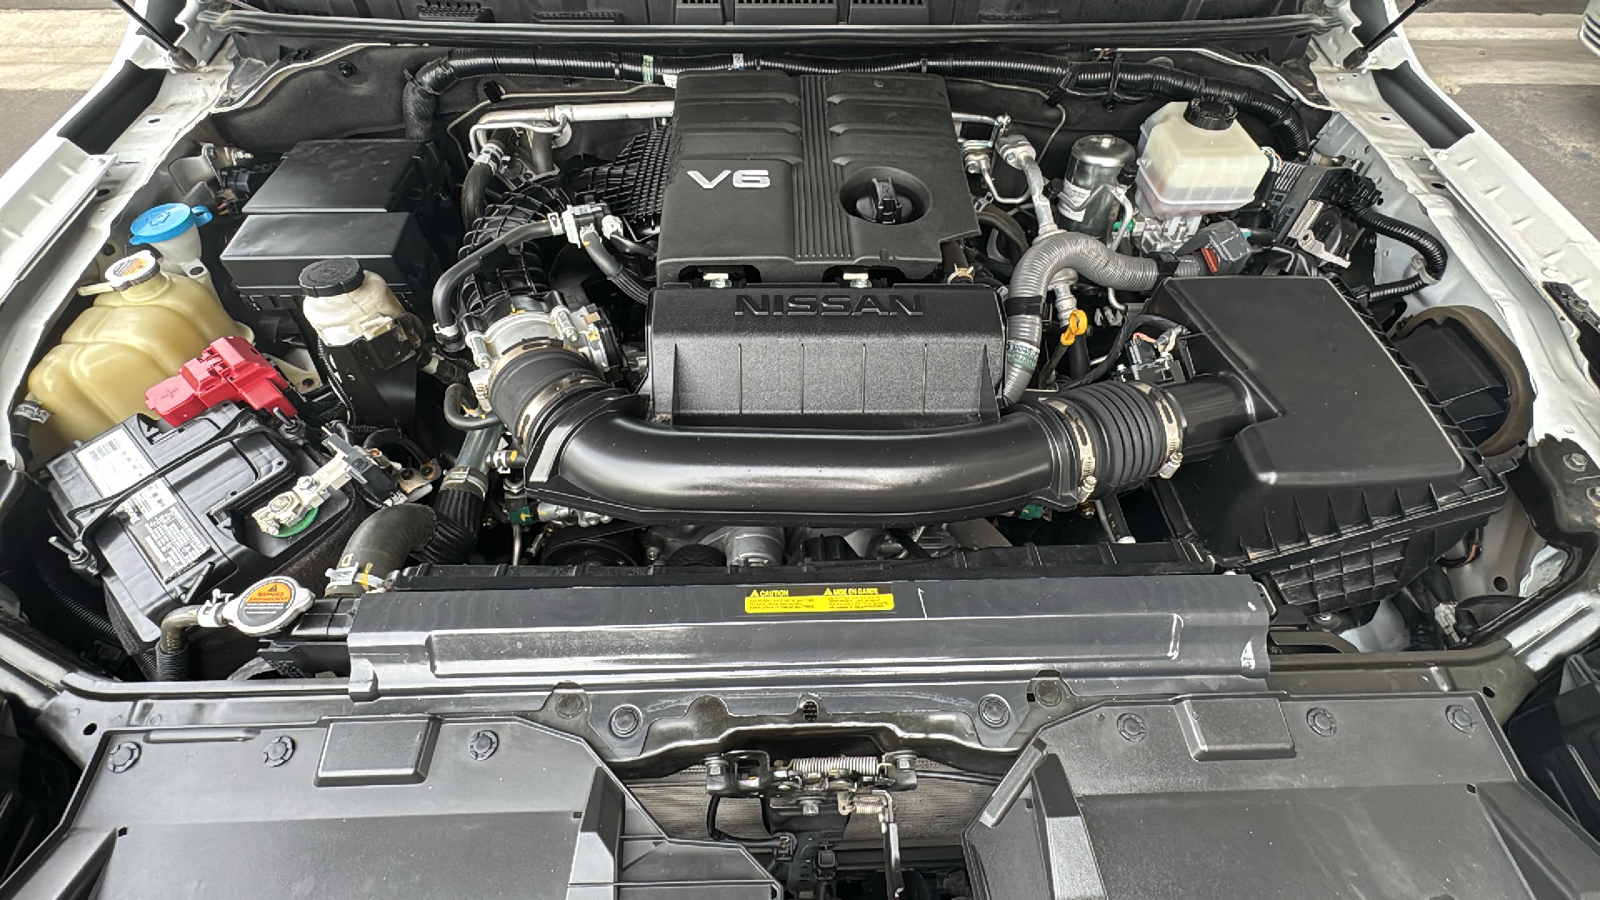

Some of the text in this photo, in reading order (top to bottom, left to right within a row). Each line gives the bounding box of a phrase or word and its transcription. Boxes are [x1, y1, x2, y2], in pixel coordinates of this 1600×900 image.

[687, 169, 771, 189] V6
[734, 294, 924, 316] NISSAN
[759, 589, 789, 597] CAUTION
[857, 587, 879, 595] GARDE
